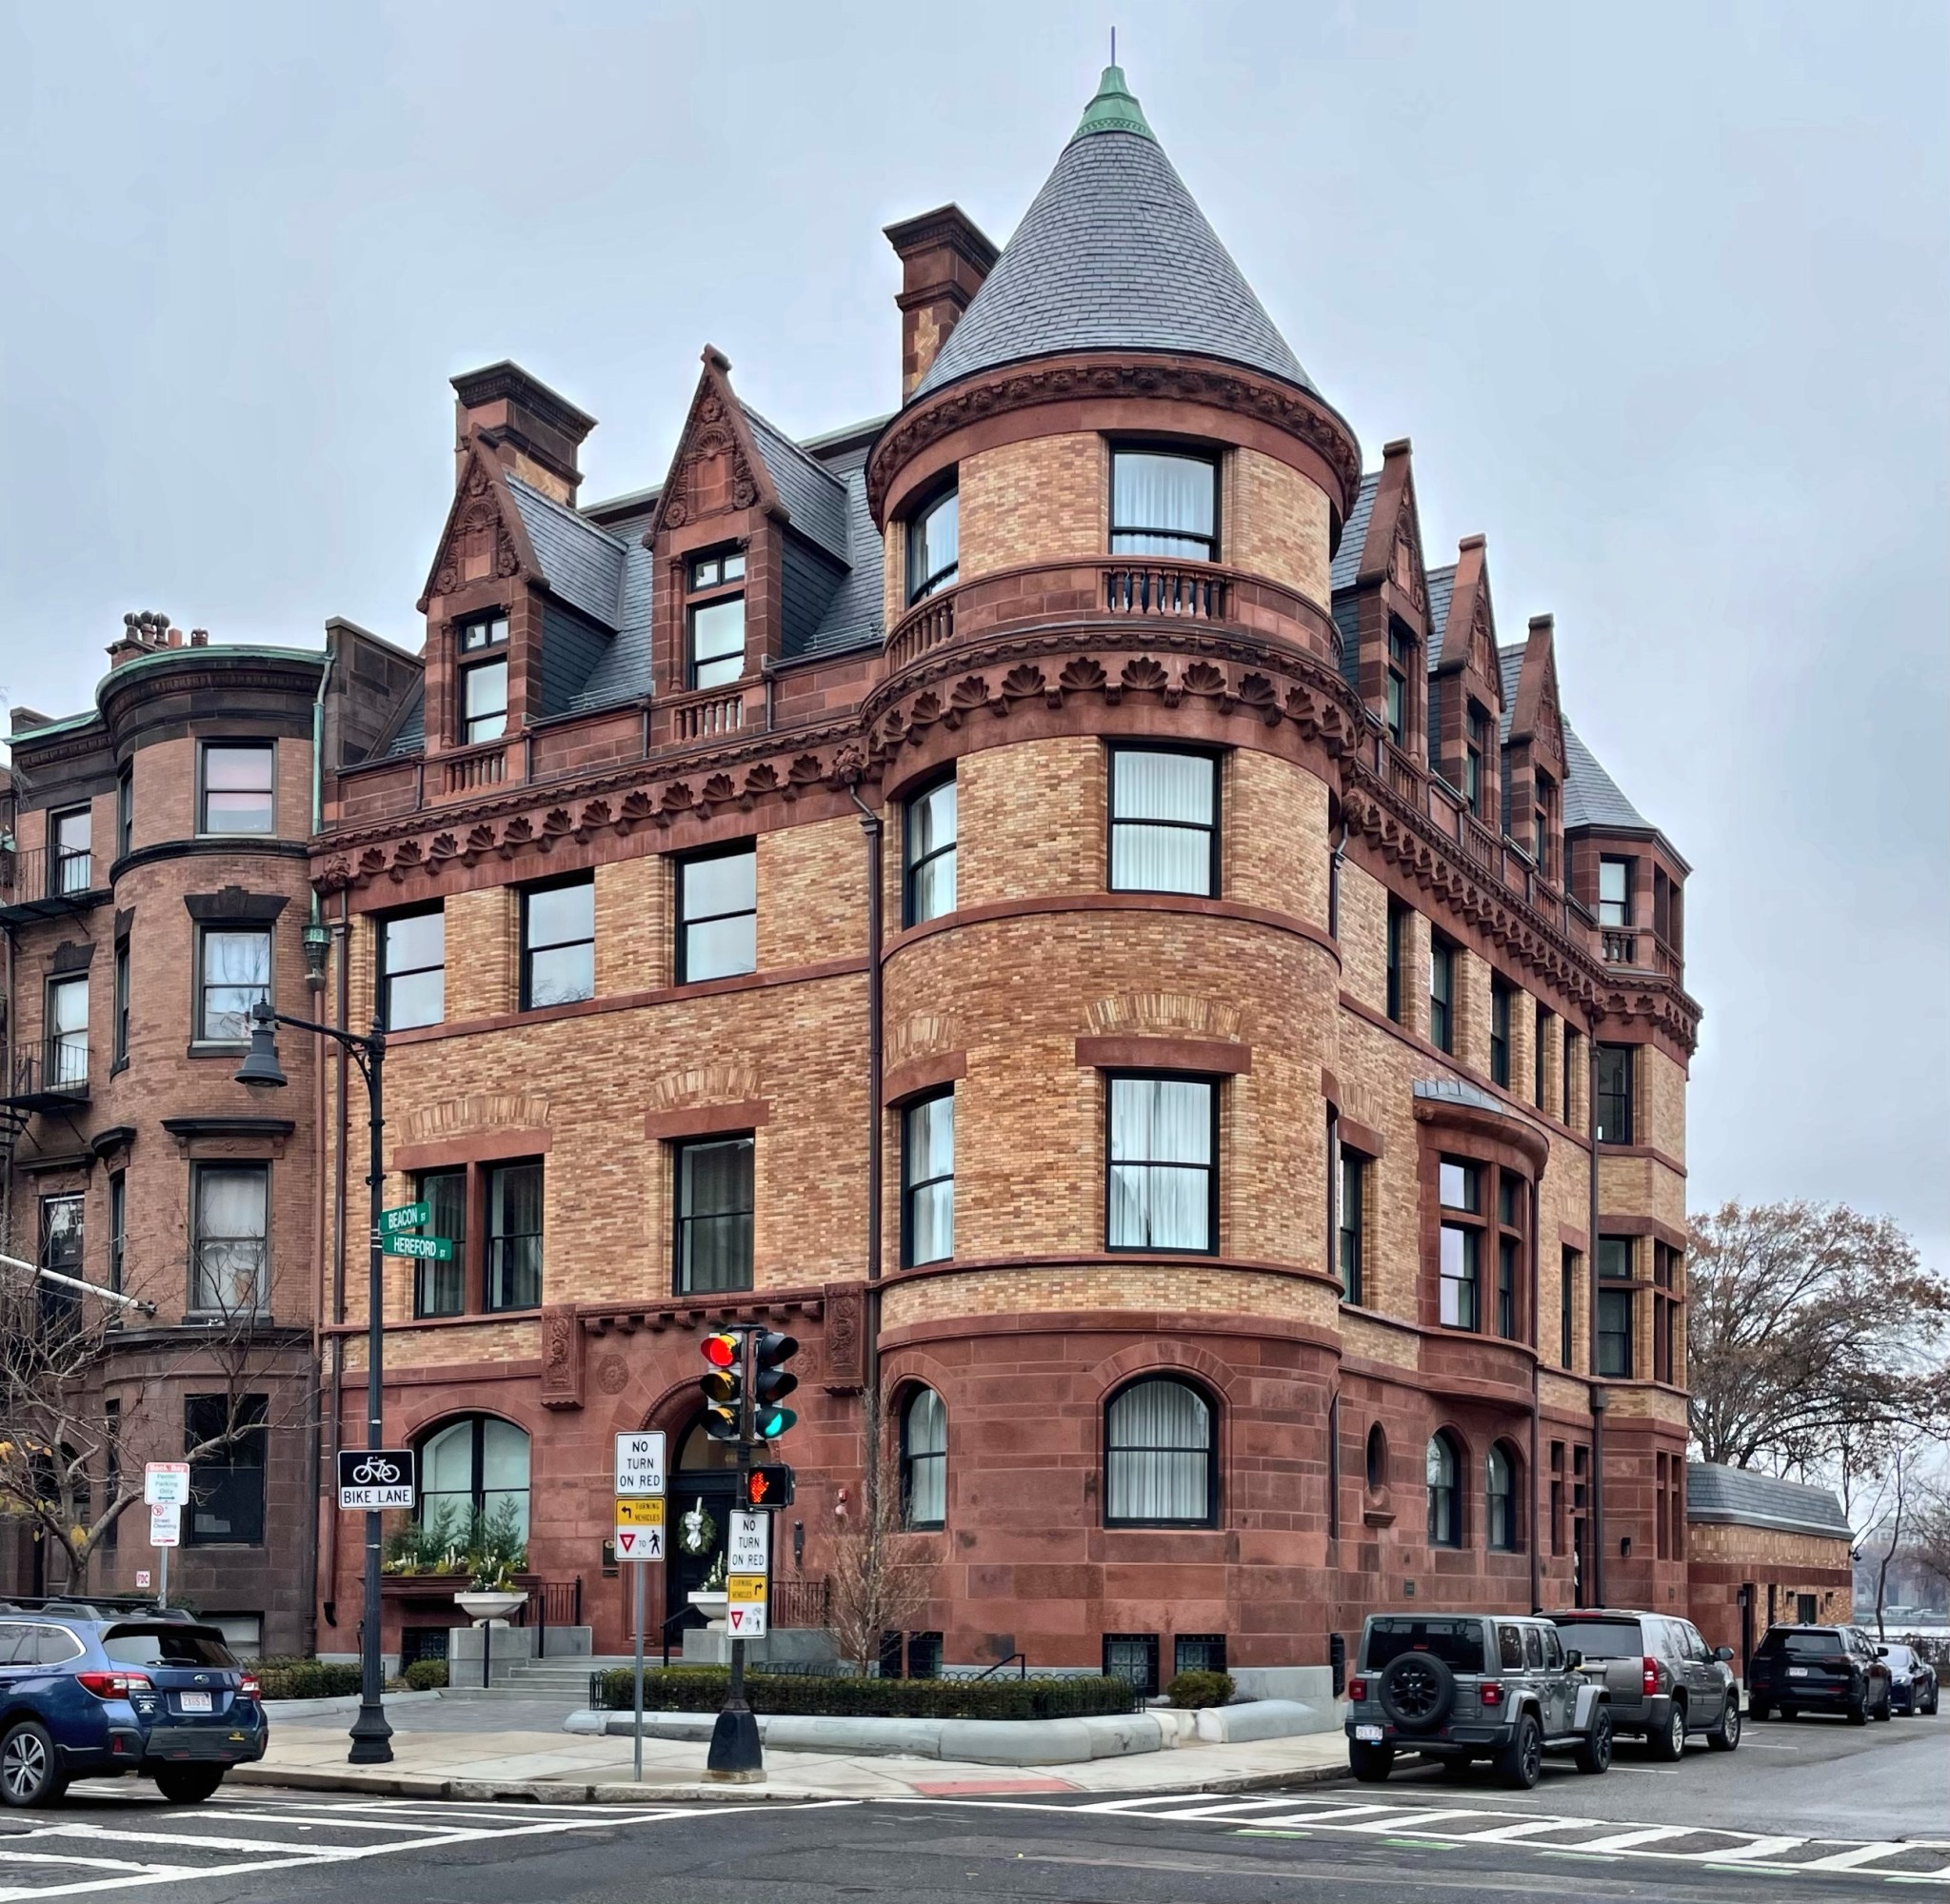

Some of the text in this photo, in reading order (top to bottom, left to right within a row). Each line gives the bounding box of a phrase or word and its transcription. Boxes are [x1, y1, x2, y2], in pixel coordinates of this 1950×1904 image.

[388, 1208, 426, 1229] BEACON ST
[394, 1237, 446, 1258] HEREFORD ST
[632, 1440, 648, 1453] NO
[627, 1458, 654, 1470] TURN
[620, 1475, 661, 1487] ON RED
[344, 1489, 409, 1503] BIKE LANE
[635, 1514, 660, 1522] VEHICLES
[743, 1519, 756, 1532] NO
[638, 1539, 647, 1548] TO
[738, 1537, 760, 1549] TURN
[732, 1554, 765, 1566] ON RED
